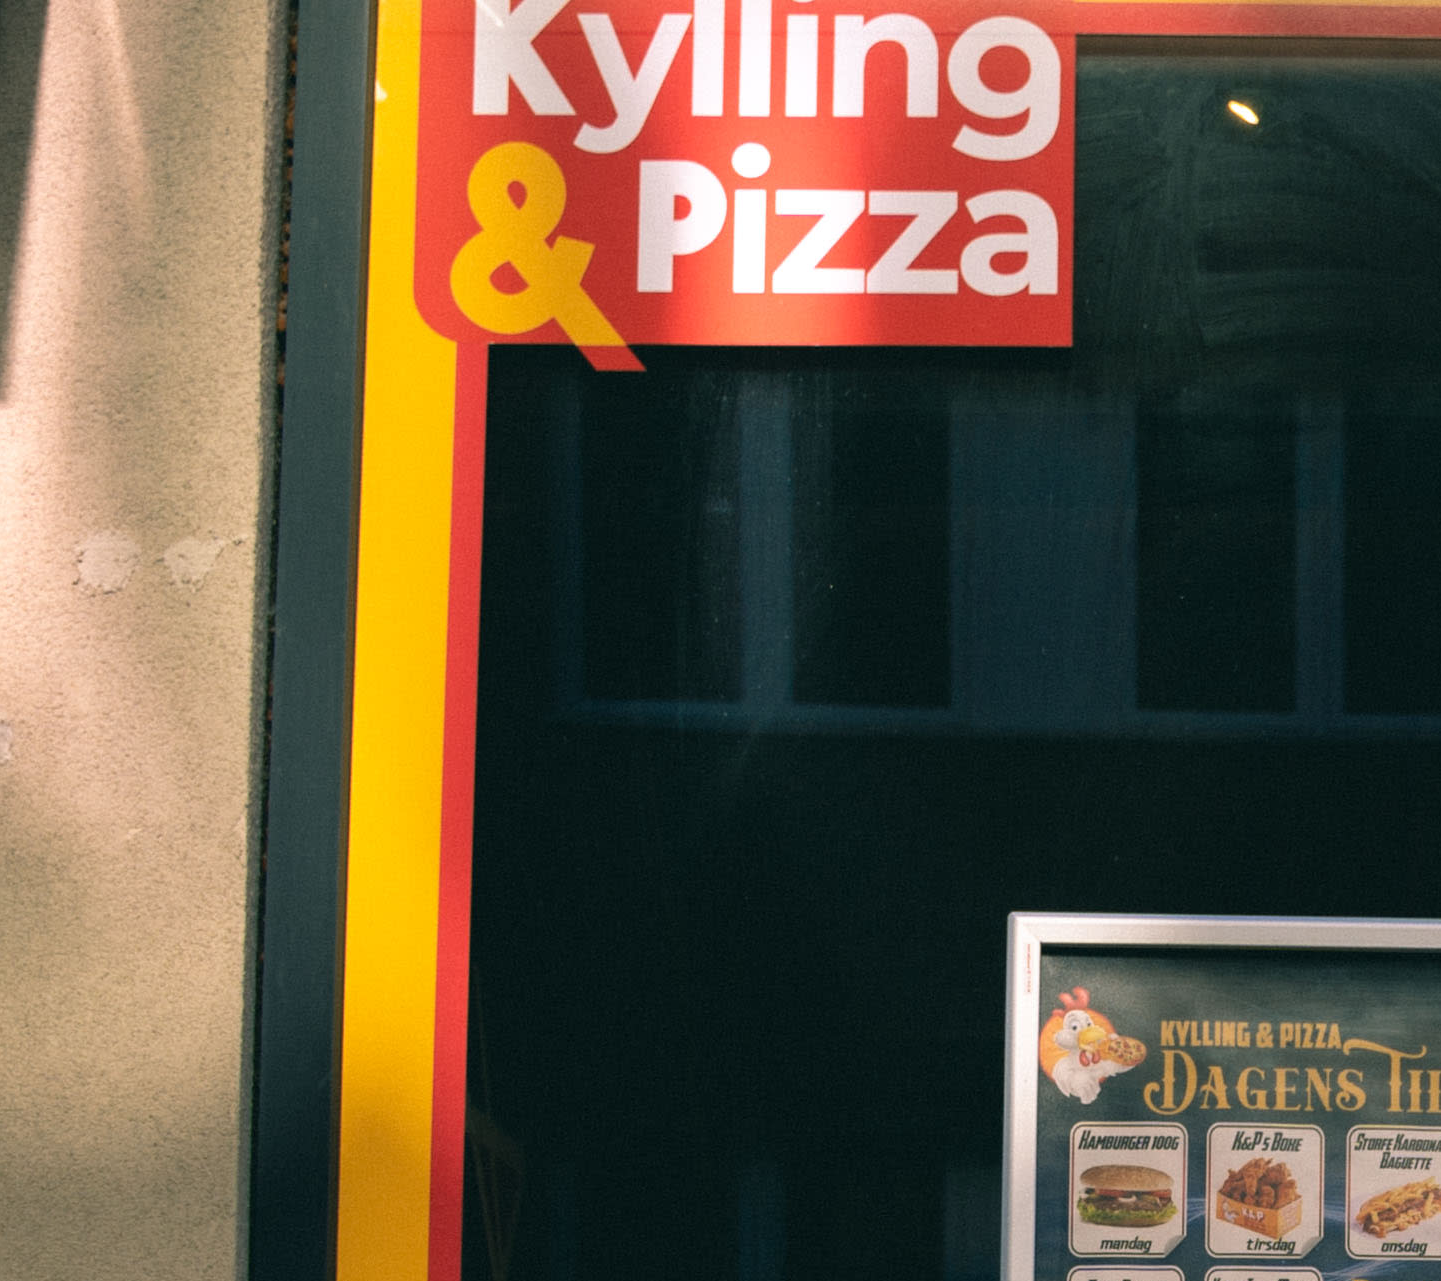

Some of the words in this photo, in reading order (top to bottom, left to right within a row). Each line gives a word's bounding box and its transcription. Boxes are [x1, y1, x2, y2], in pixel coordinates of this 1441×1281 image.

[473, 0, 1061, 161] Kylling
[451, 142, 646, 372] &
[637, 142, 1058, 297] Pizza
[1160, 1020, 1251, 1049] KYLLING
[1255, 1021, 1275, 1049] &
[1279, 1022, 1343, 1050] PIZZA
[1100, 1235, 1153, 1253] mandag
[1246, 1236, 1297, 1255] tirsdag
[1380, 1239, 1429, 1256] onsdag
